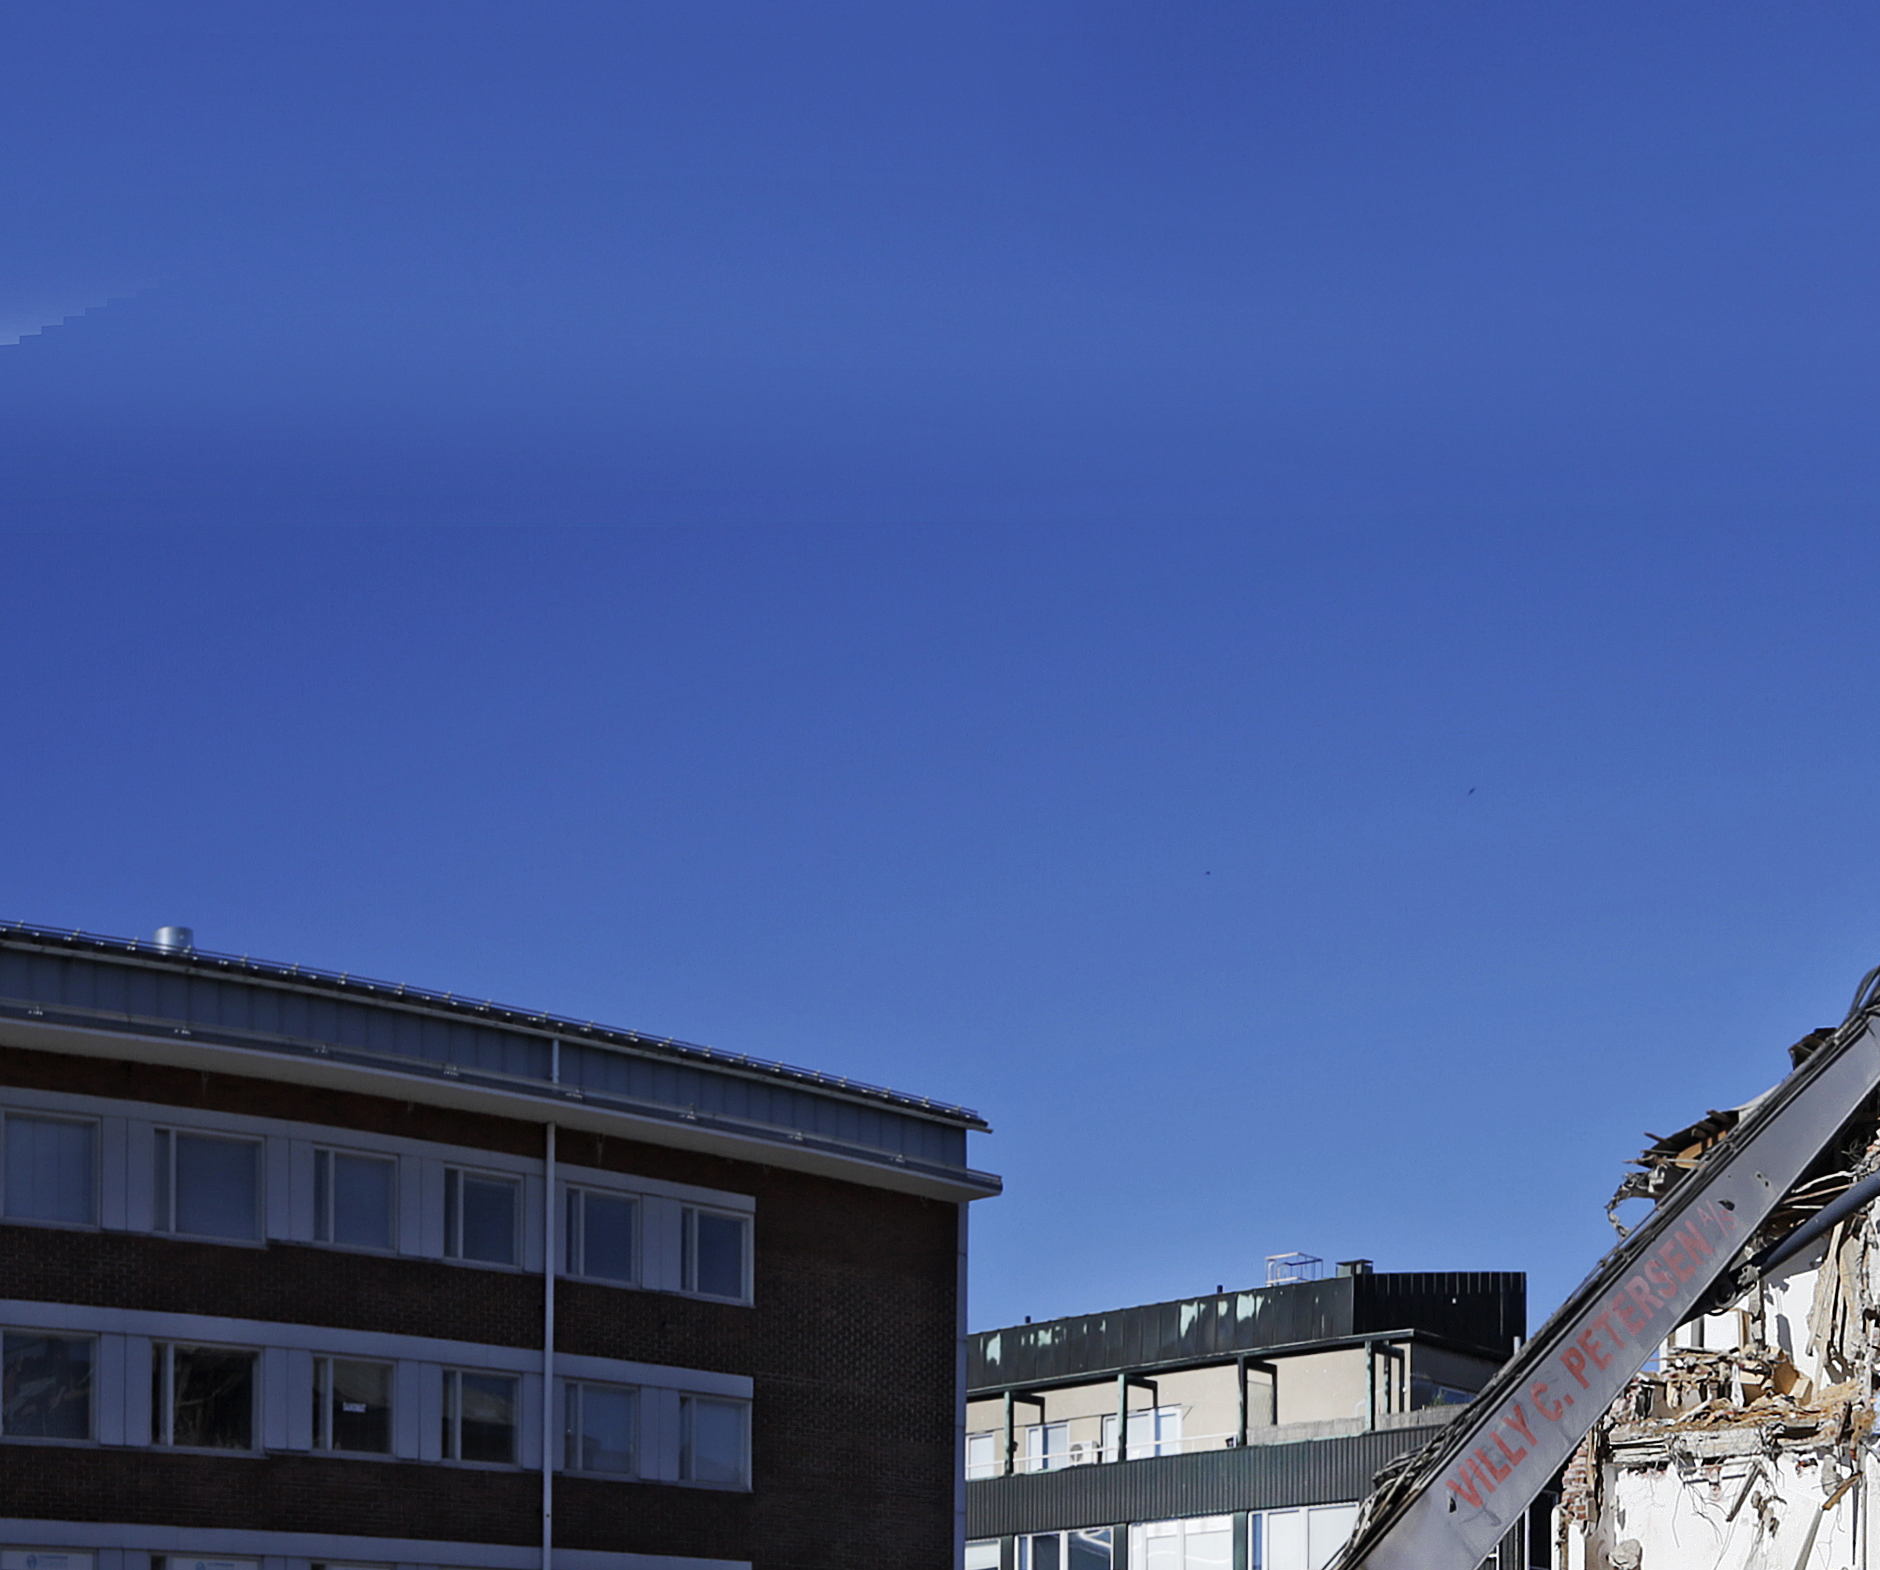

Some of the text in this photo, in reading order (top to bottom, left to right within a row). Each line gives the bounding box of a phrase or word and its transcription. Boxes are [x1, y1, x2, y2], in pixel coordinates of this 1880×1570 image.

[1445, 1404, 1540, 1509] VILLY
[1529, 1380, 1576, 1423] C.
[1559, 1218, 1718, 1391] PETERSEN
